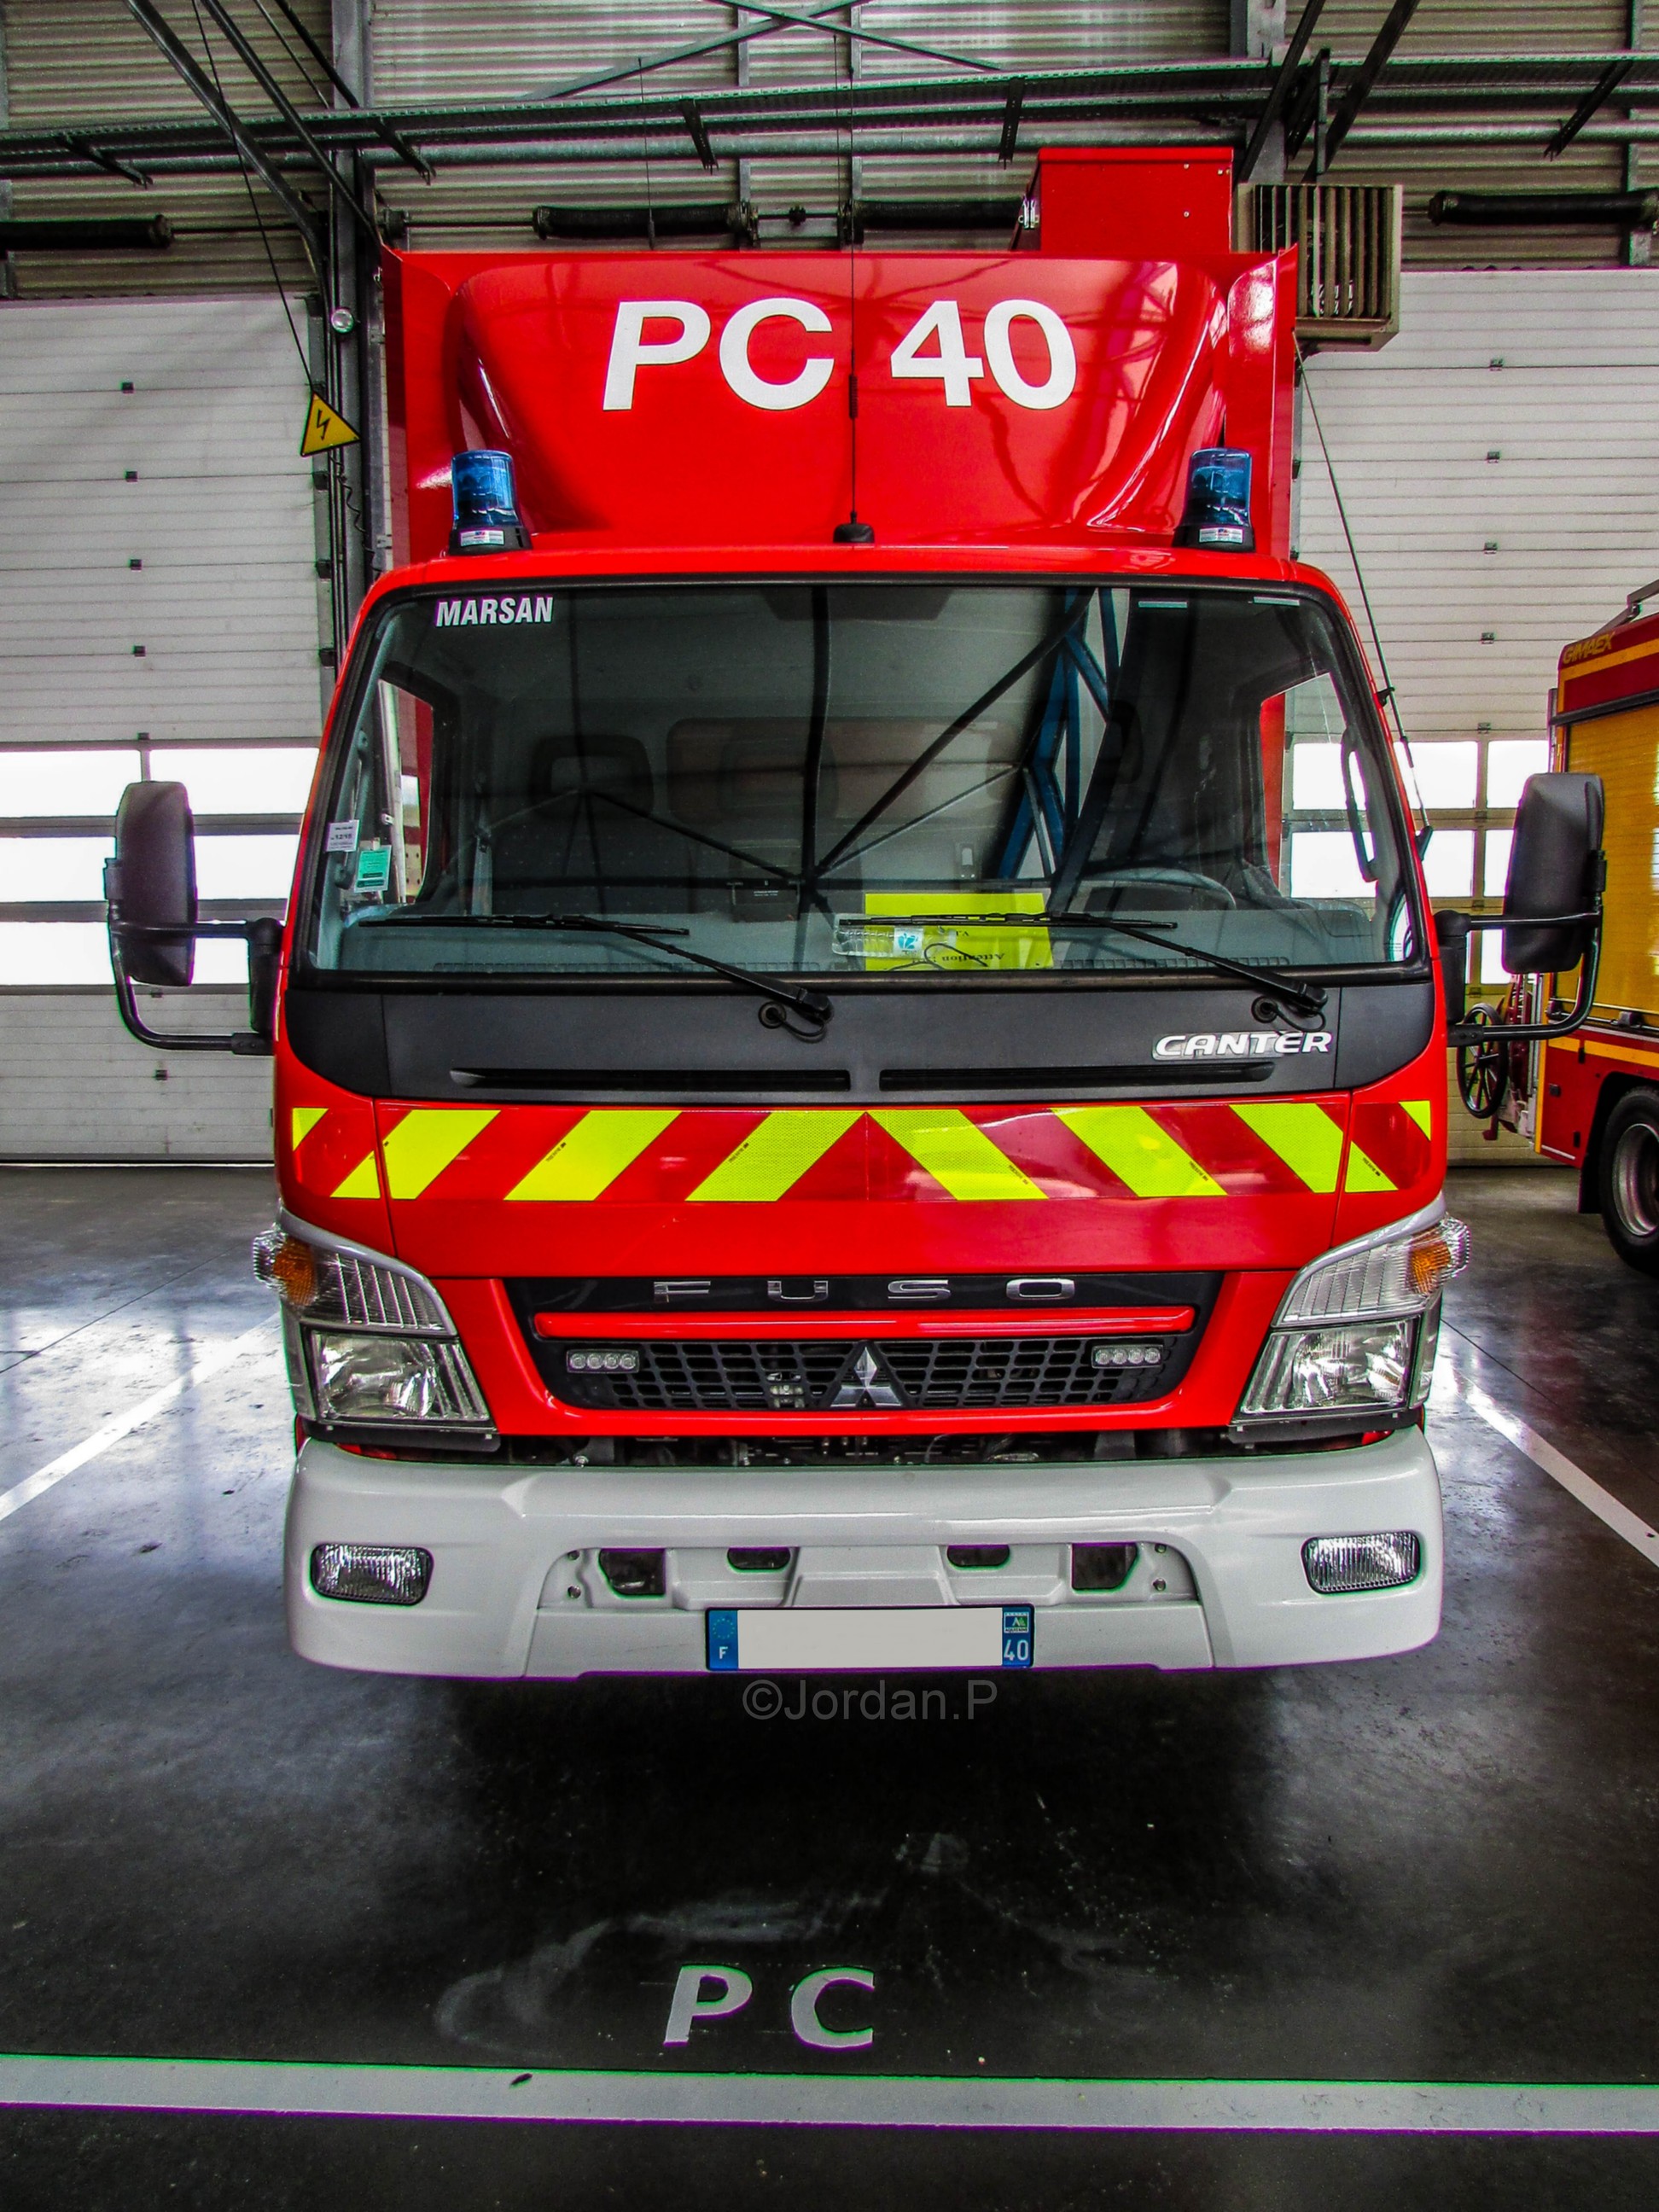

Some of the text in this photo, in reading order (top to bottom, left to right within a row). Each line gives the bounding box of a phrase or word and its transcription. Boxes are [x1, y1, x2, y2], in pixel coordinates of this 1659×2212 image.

[602, 297, 1077, 410] PC 40
[435, 597, 553, 627] MARSAN
[1563, 632, 1615, 664] GIMAEX
[1155, 1031, 1333, 1057] CANTER
[654, 1279, 1075, 1302] FUSO
[719, 1646, 729, 1660] F
[1004, 1639, 1029, 1661] 40
[663, 1965, 876, 2052] PC
